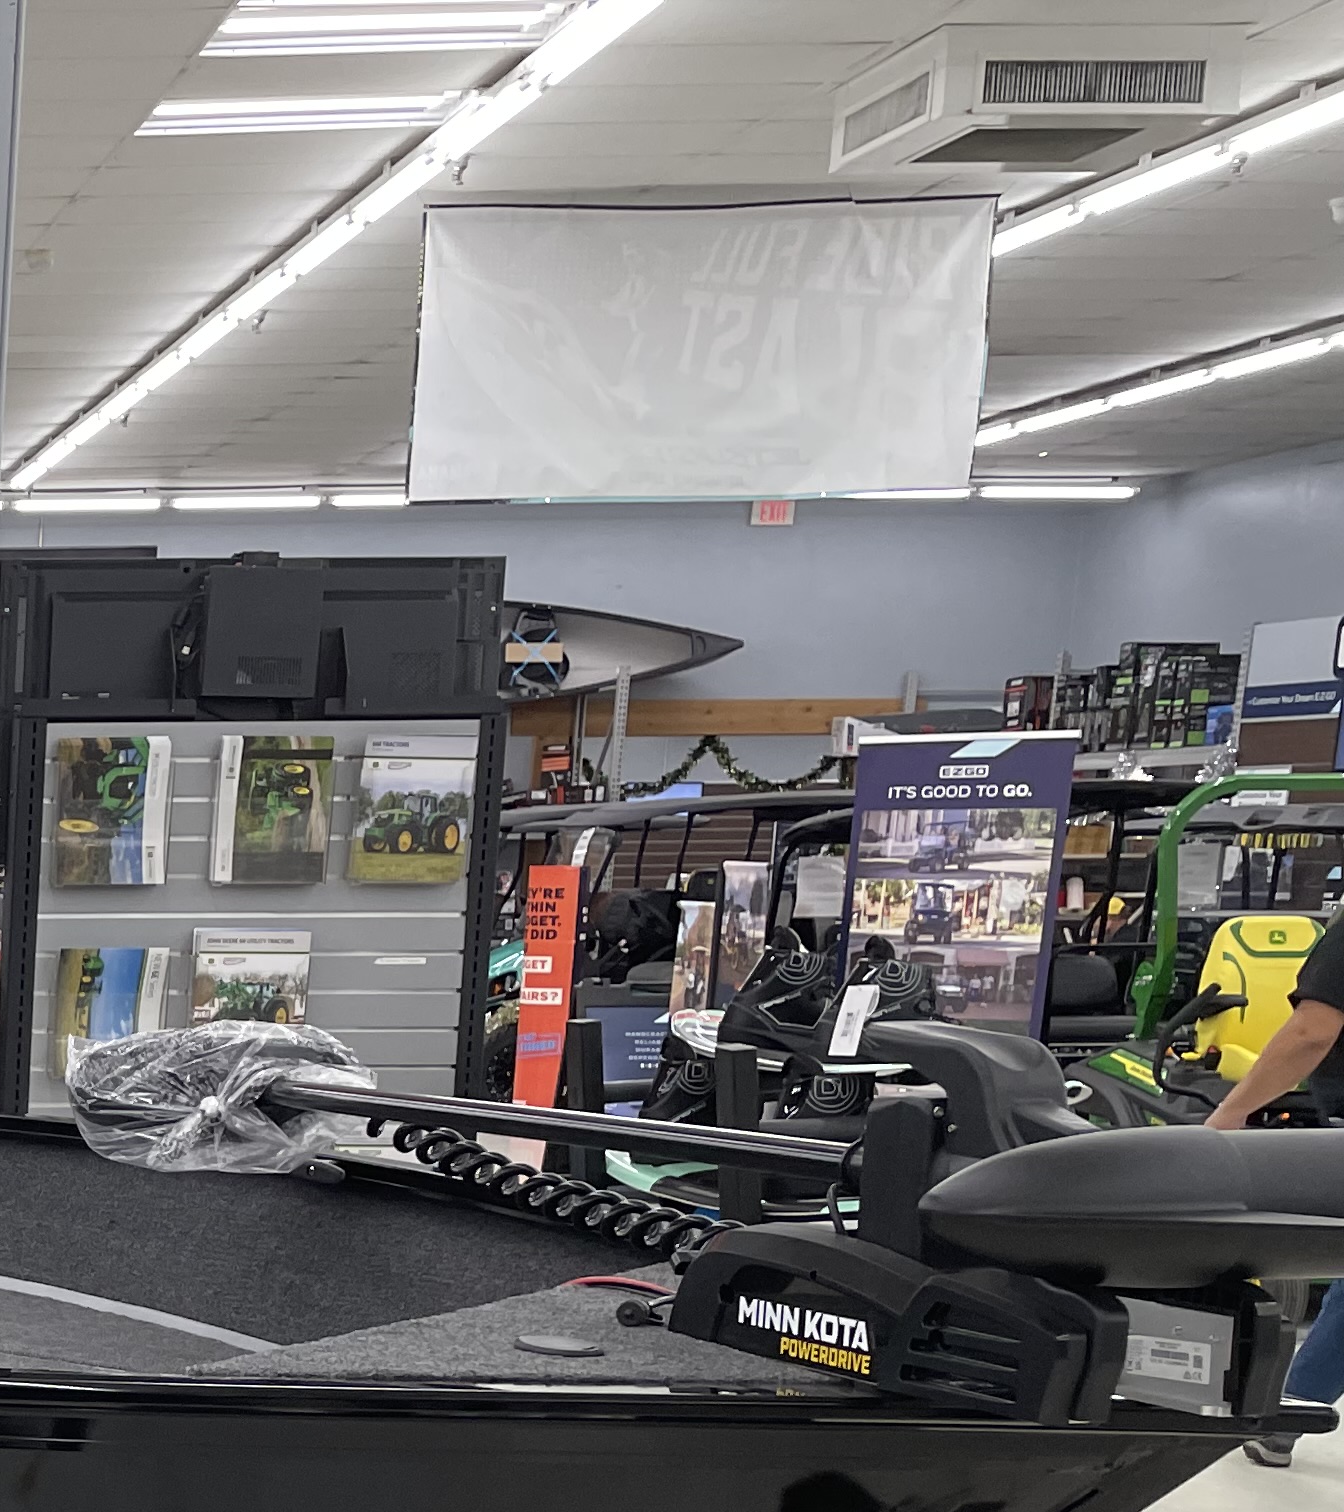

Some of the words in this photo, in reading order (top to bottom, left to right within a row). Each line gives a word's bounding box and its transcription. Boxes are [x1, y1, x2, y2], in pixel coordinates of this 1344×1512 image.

[758, 500, 788, 522] EXIT
[942, 767, 987, 777] EZGO
[887, 786, 917, 799] IT'S
[920, 785, 971, 799] GOOD
[976, 784, 998, 797] TO
[1002, 783, 1033, 797] GO.
[530, 929, 558, 940] DID
[738, 1296, 800, 1336] MINN
[804, 1309, 869, 1352] KOTA
[779, 1336, 871, 1375] POWERDRIVE
